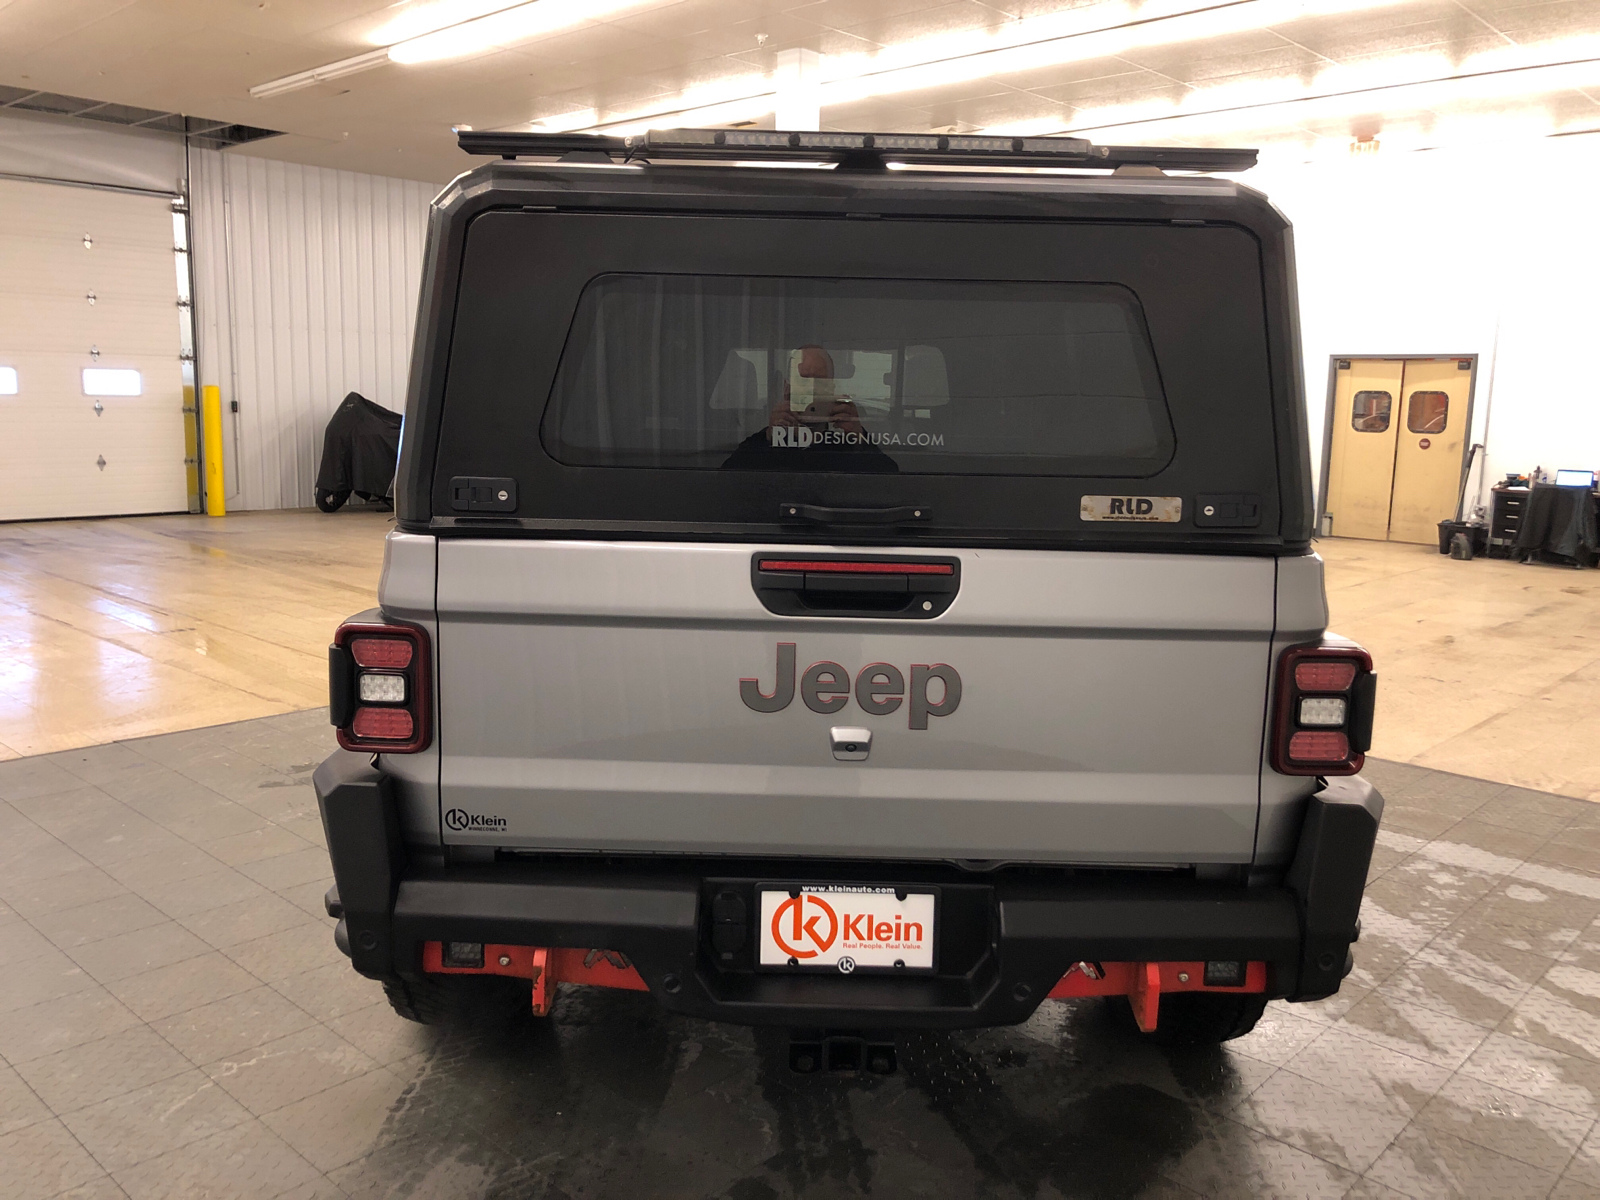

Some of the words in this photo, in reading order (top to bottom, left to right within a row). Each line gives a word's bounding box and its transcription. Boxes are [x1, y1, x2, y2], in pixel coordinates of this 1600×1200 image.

[1109, 498, 1153, 515] RLD
[739, 642, 962, 730] Jeep
[471, 815, 507, 826] Klein
[802, 885, 895, 894] www.kleinauto.com
[843, 914, 922, 941] Klein
